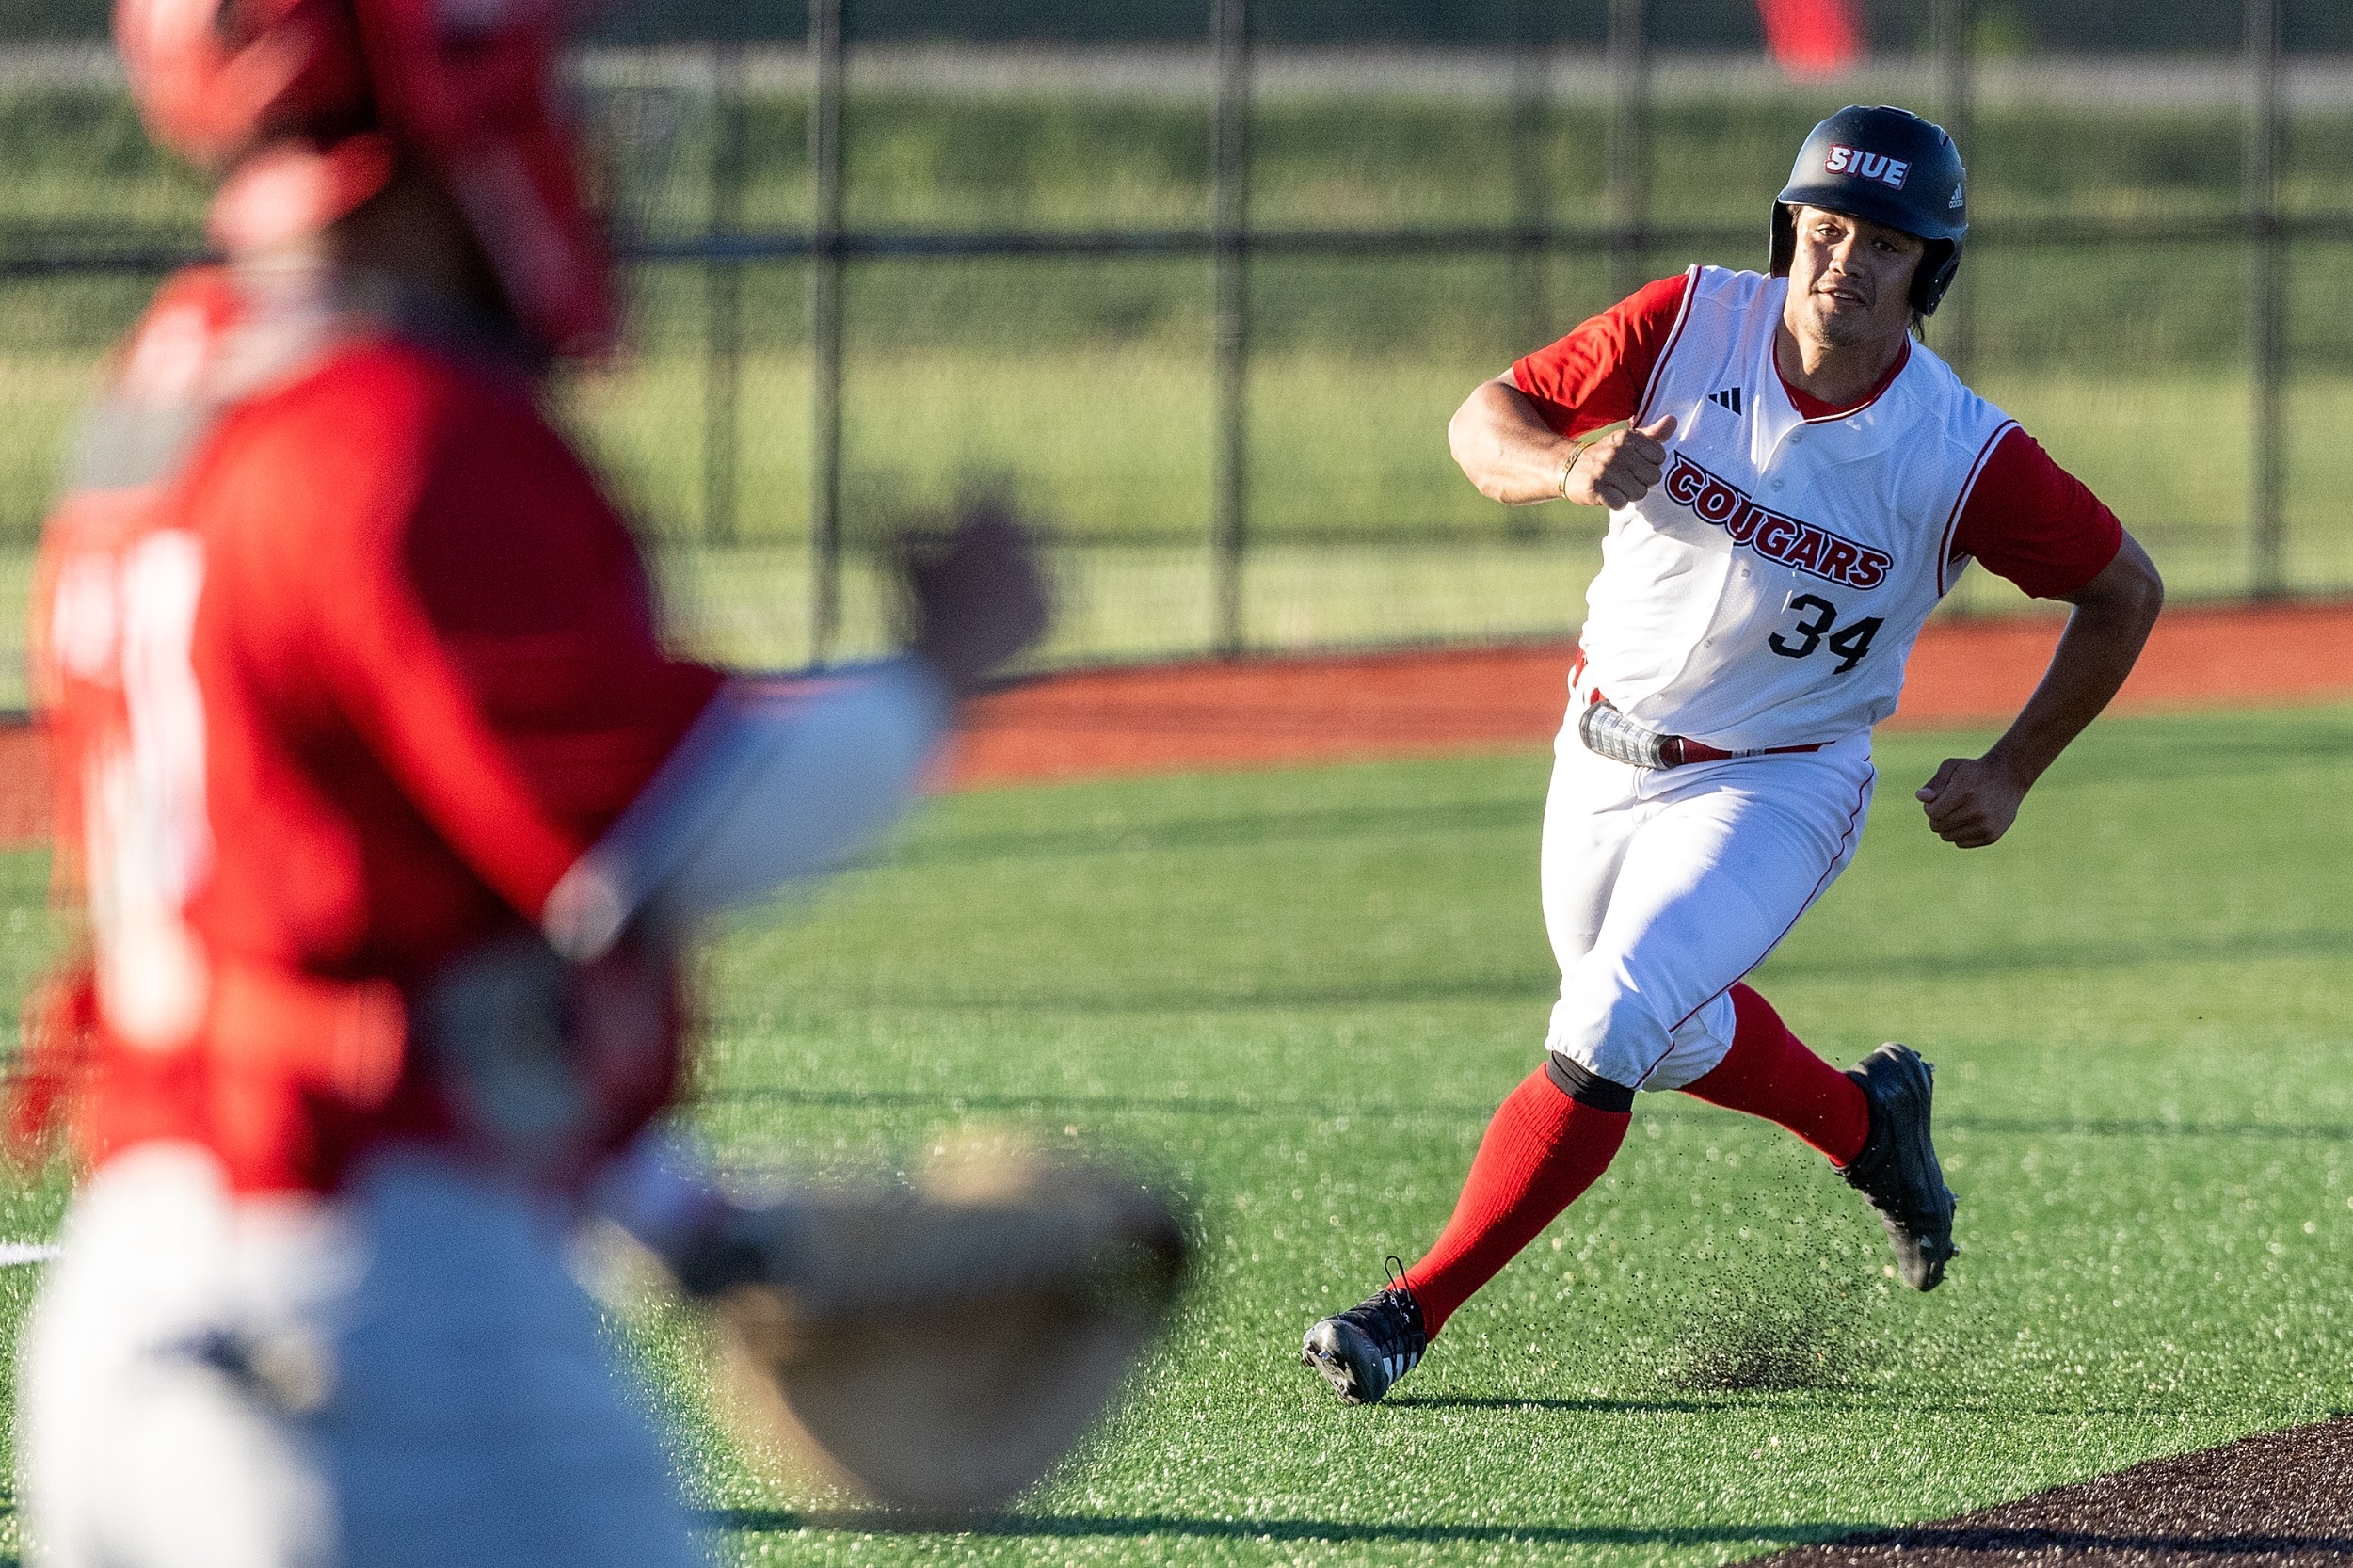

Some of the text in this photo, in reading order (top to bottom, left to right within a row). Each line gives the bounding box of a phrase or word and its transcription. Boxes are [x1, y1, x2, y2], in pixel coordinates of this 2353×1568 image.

[1824, 144, 1912, 190] SIUE
[1665, 450, 1894, 590] COUGARS
[1768, 594, 1885, 675] 34
